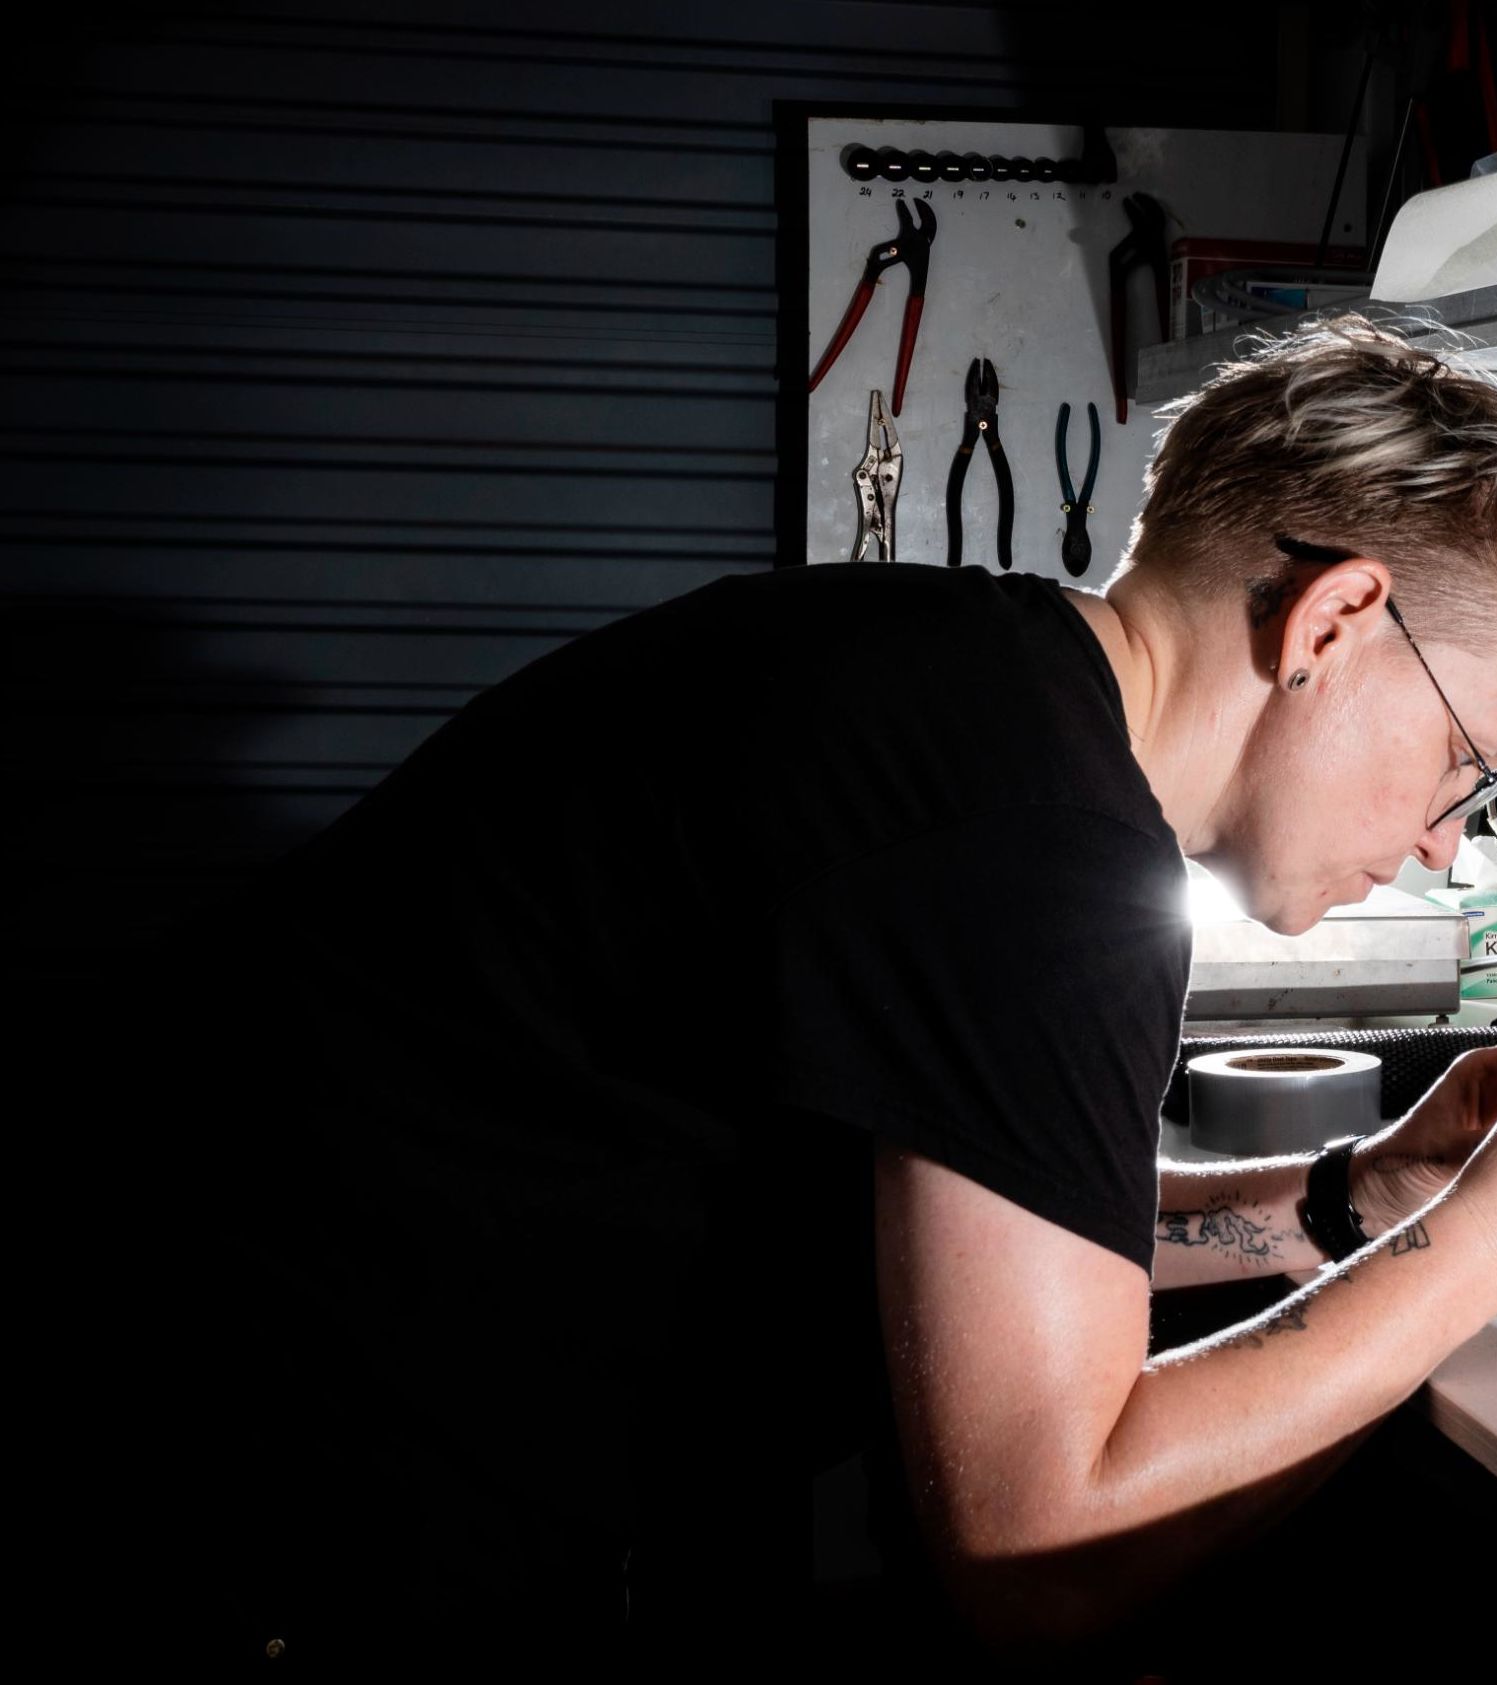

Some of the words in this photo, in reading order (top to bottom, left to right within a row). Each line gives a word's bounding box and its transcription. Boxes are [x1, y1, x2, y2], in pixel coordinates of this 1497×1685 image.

[859, 187, 872, 197] 24
[892, 188, 904, 198] 22
[923, 190, 933, 199] 21
[953, 190, 964, 199] 19
[980, 191, 989, 200] 17
[1007, 192, 1017, 202] 14
[1053, 192, 1065, 201] 12
[1080, 191, 1086, 200] 11
[1102, 191, 1111, 200] 10
